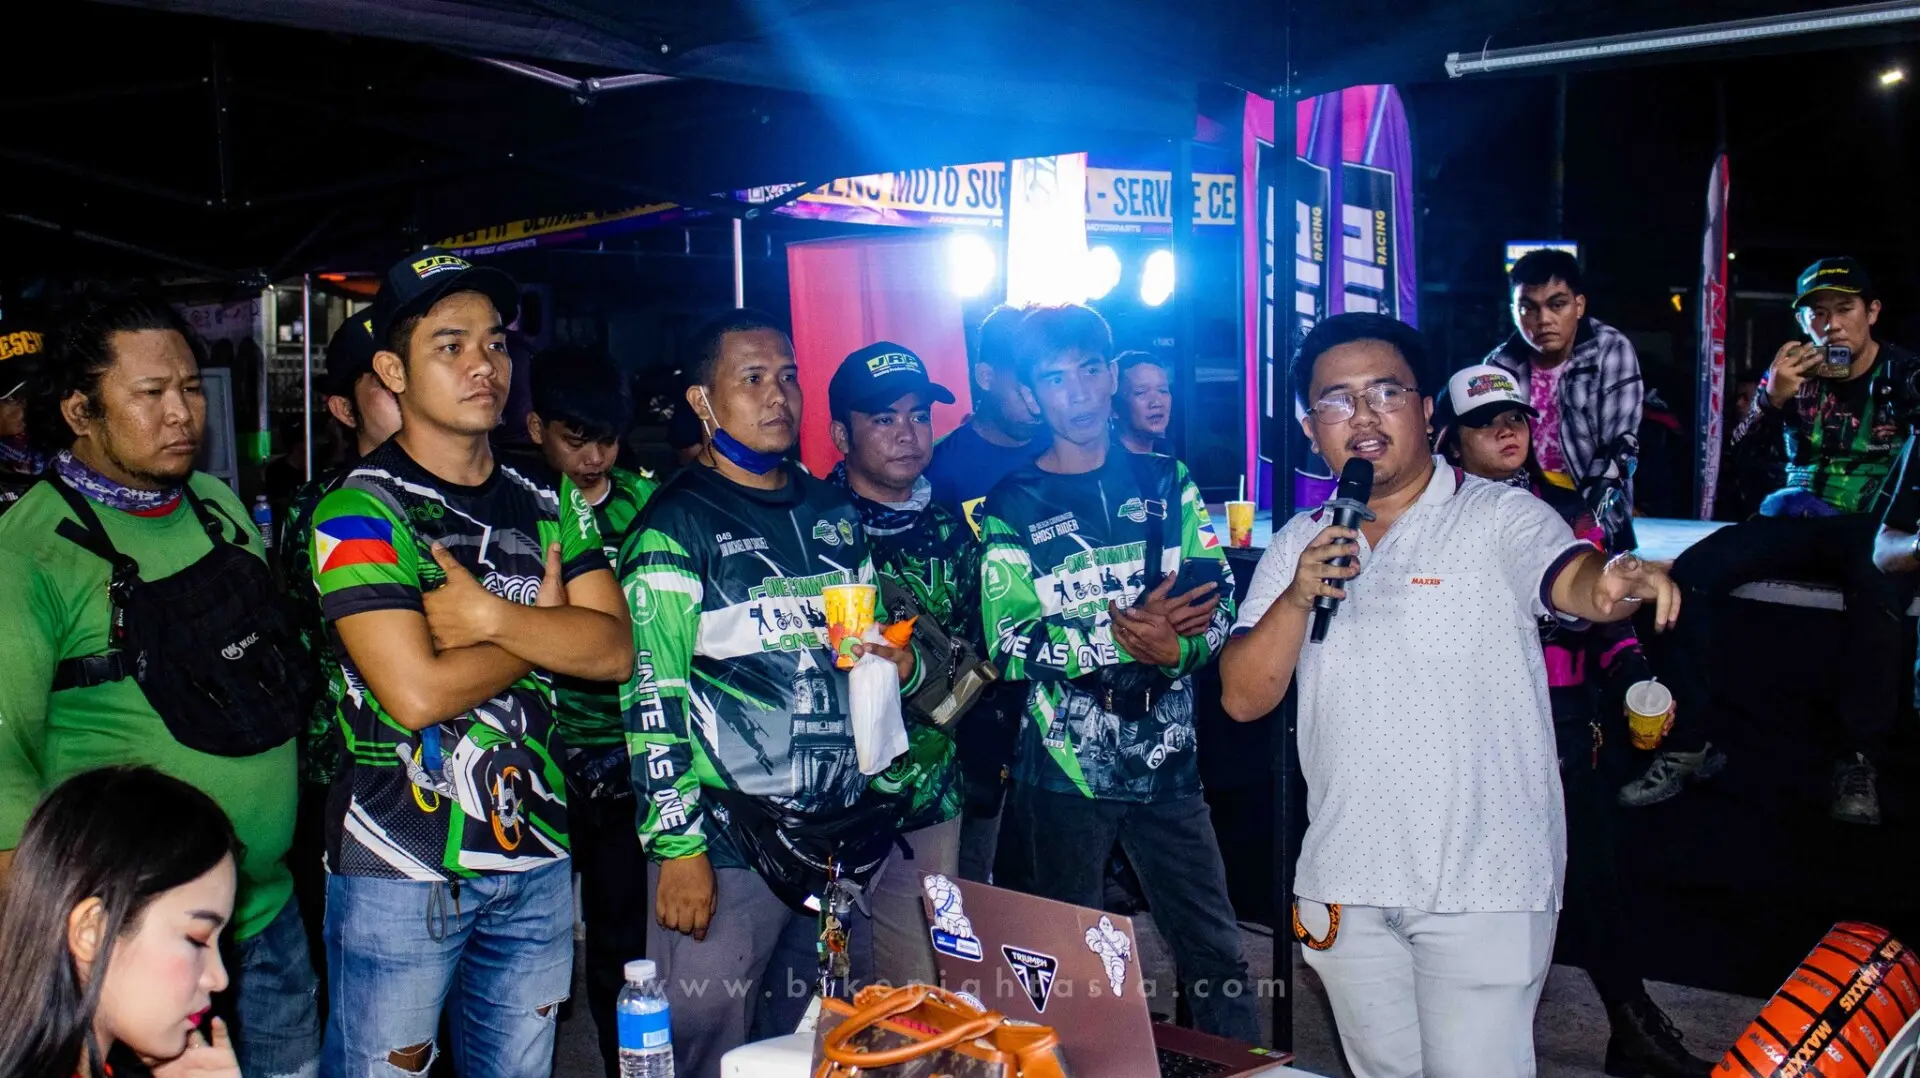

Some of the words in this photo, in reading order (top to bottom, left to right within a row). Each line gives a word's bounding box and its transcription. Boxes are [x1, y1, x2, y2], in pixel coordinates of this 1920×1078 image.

[1113, 176, 1202, 218] SERVE
[1312, 206, 1324, 262] RACING
[1376, 209, 1387, 266] RACING
[715, 531, 732, 543] 049
[1031, 526, 1056, 545] GHOST
[1055, 519, 1080, 536] RIDER
[1410, 577, 1441, 586] MAXXIS
[1035, 642, 1070, 665] AS
[1078, 644, 1120, 667] ONE
[637, 651, 666, 731] UNITE
[645, 742, 674, 780] AS
[653, 788, 688, 831] ONE
[1011, 951, 1048, 967] TRIUMPH
